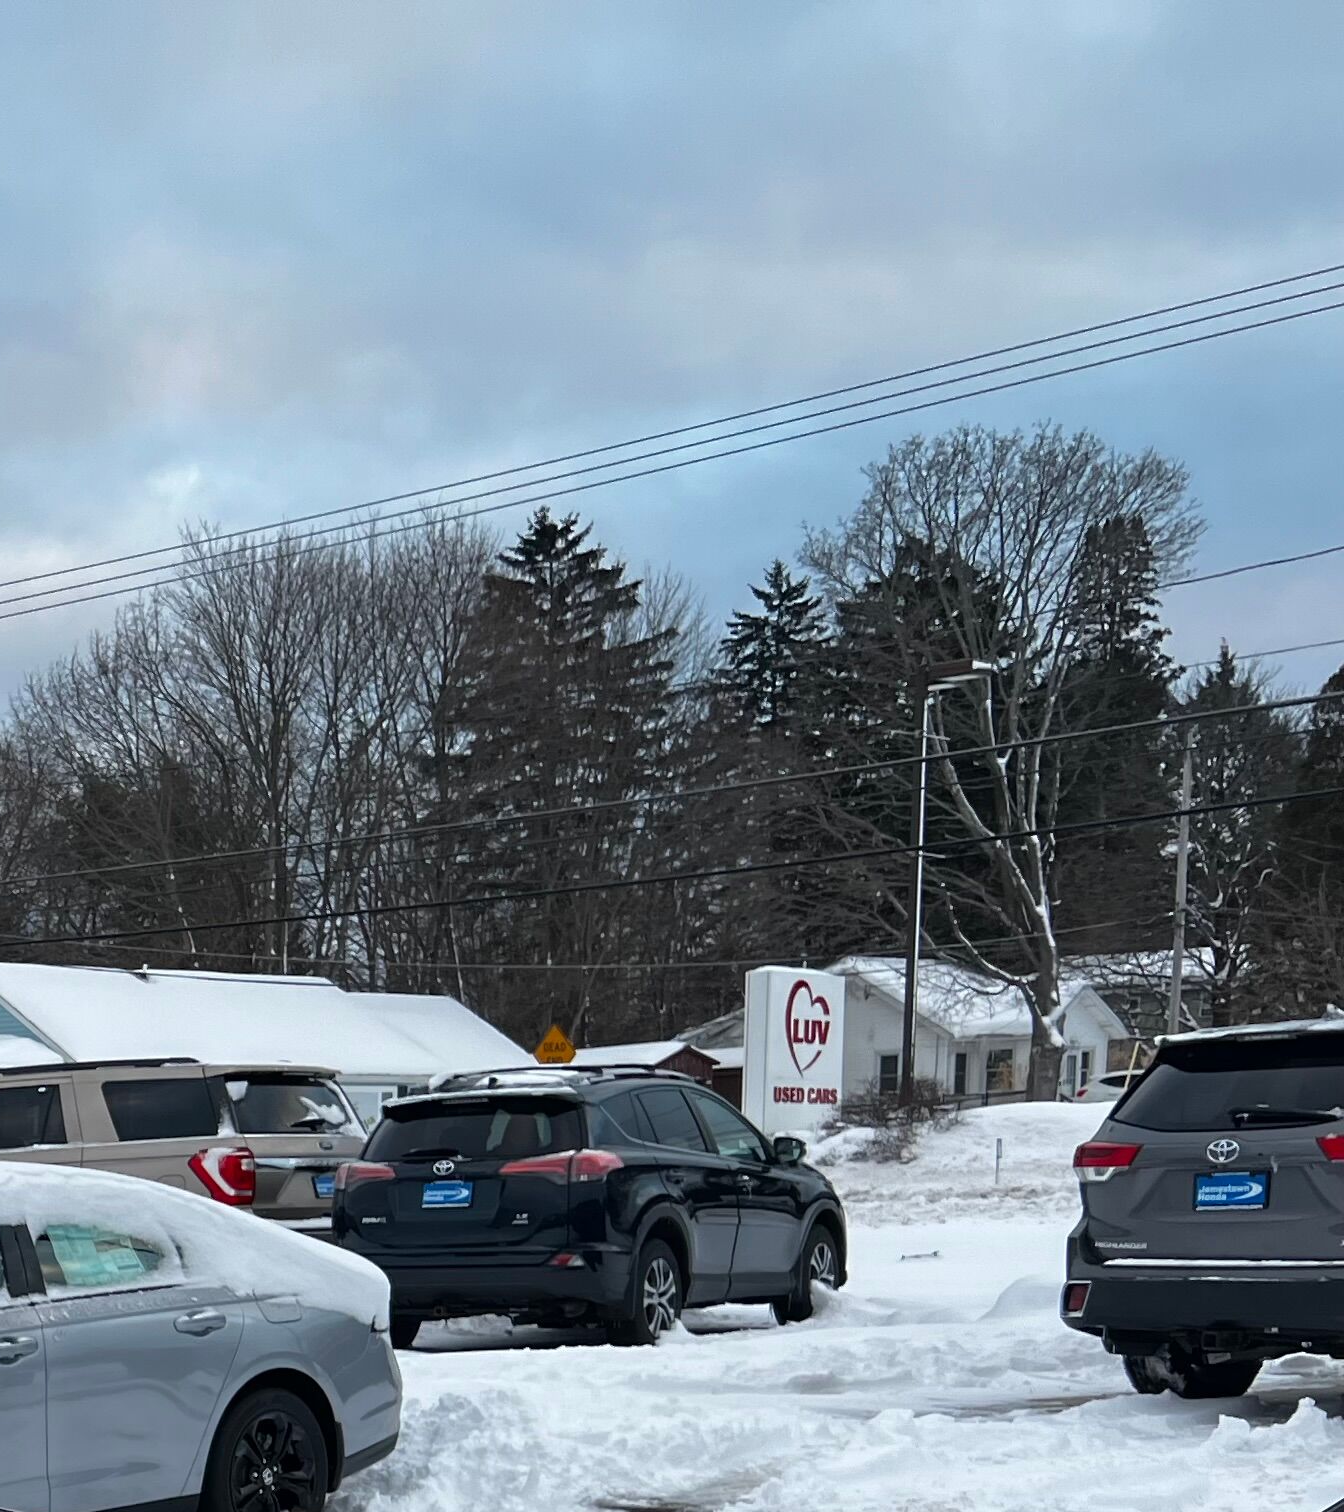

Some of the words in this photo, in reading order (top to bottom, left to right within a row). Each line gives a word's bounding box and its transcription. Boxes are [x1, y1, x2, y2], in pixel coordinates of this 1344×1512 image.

[793, 1018, 830, 1045] LUV
[543, 1042, 567, 1052] DEAD
[773, 1086, 804, 1103] USED
[807, 1087, 838, 1105] CARS
